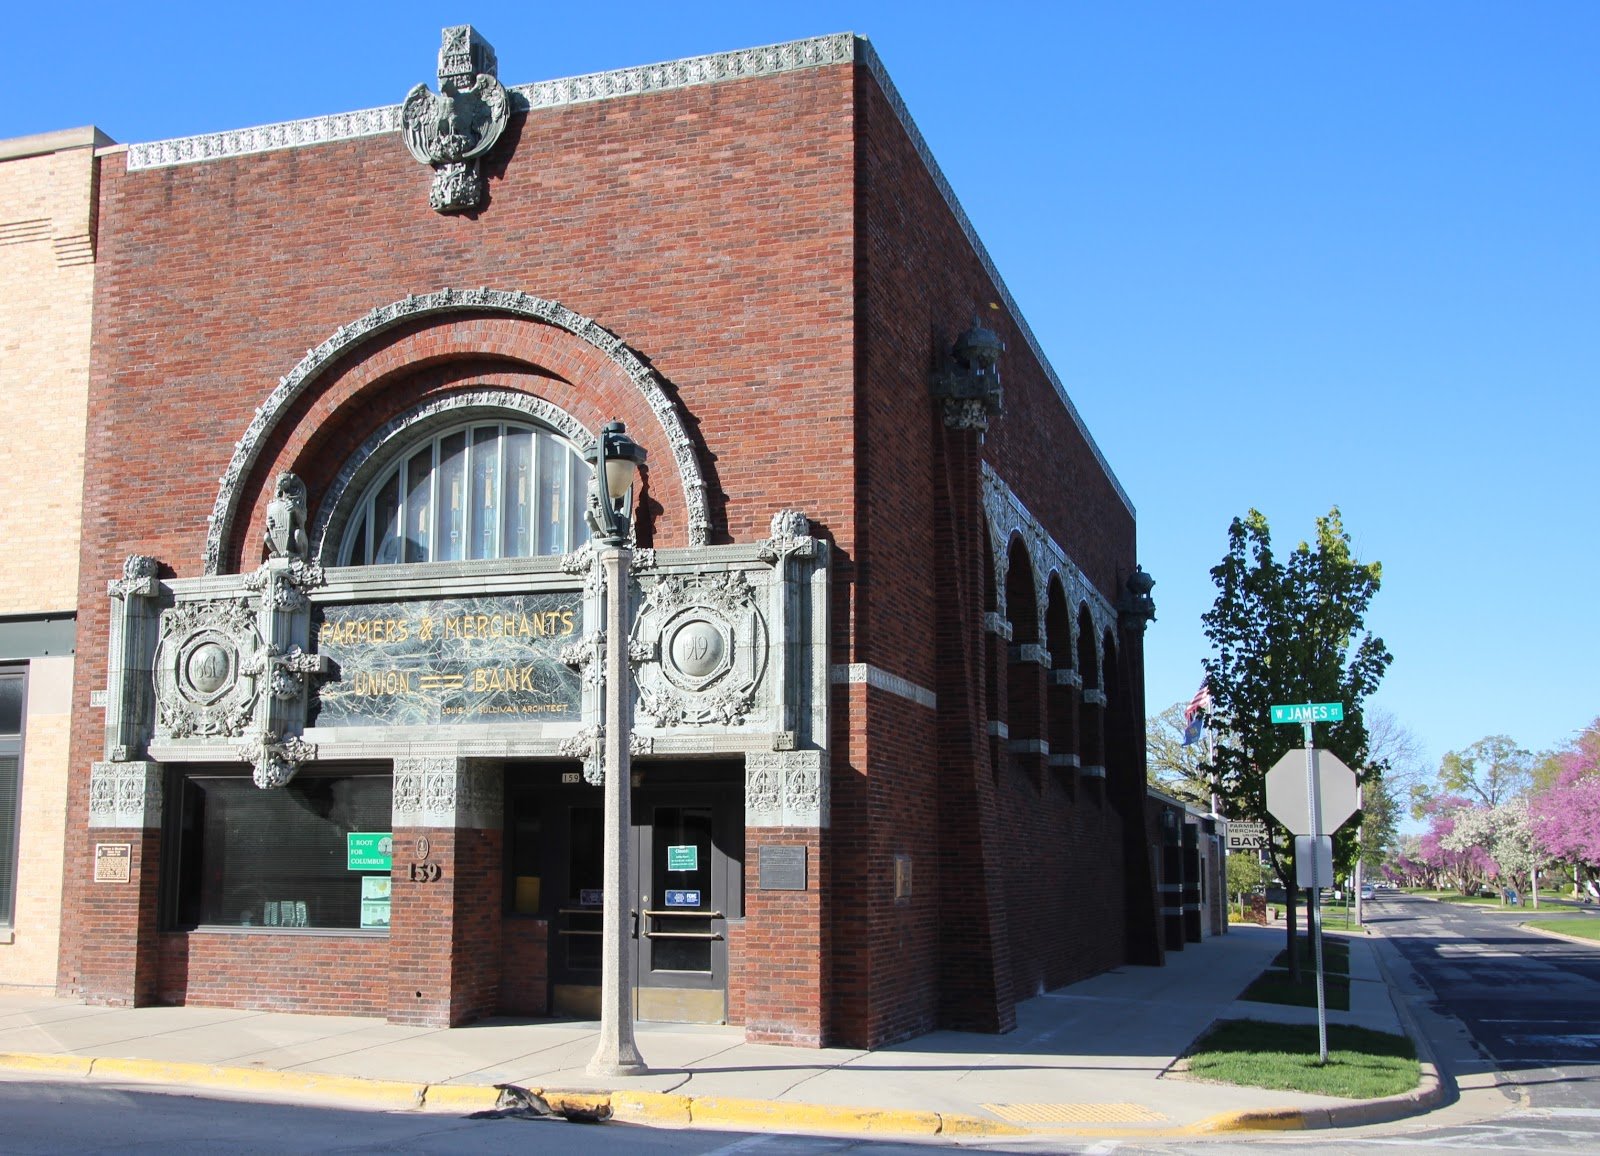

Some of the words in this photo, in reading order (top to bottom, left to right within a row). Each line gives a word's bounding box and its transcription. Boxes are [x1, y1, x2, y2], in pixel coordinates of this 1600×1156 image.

[320, 619, 409, 645] FARMERS
[419, 616, 434, 641] &
[443, 610, 575, 640] MERCHANTS
[353, 670, 411, 696] UNION
[472, 666, 536, 693] BANK
[442, 706, 463, 715] LOUIS
[478, 704, 519, 715] SULLIVAN
[521, 703, 568, 714] ARCHITECT
[1275, 709, 1283, 719] W
[1287, 706, 1328, 721] JAMES
[1330, 708, 1338, 716] ST
[564, 774, 579, 782] 159
[407, 861, 438, 881] 159
